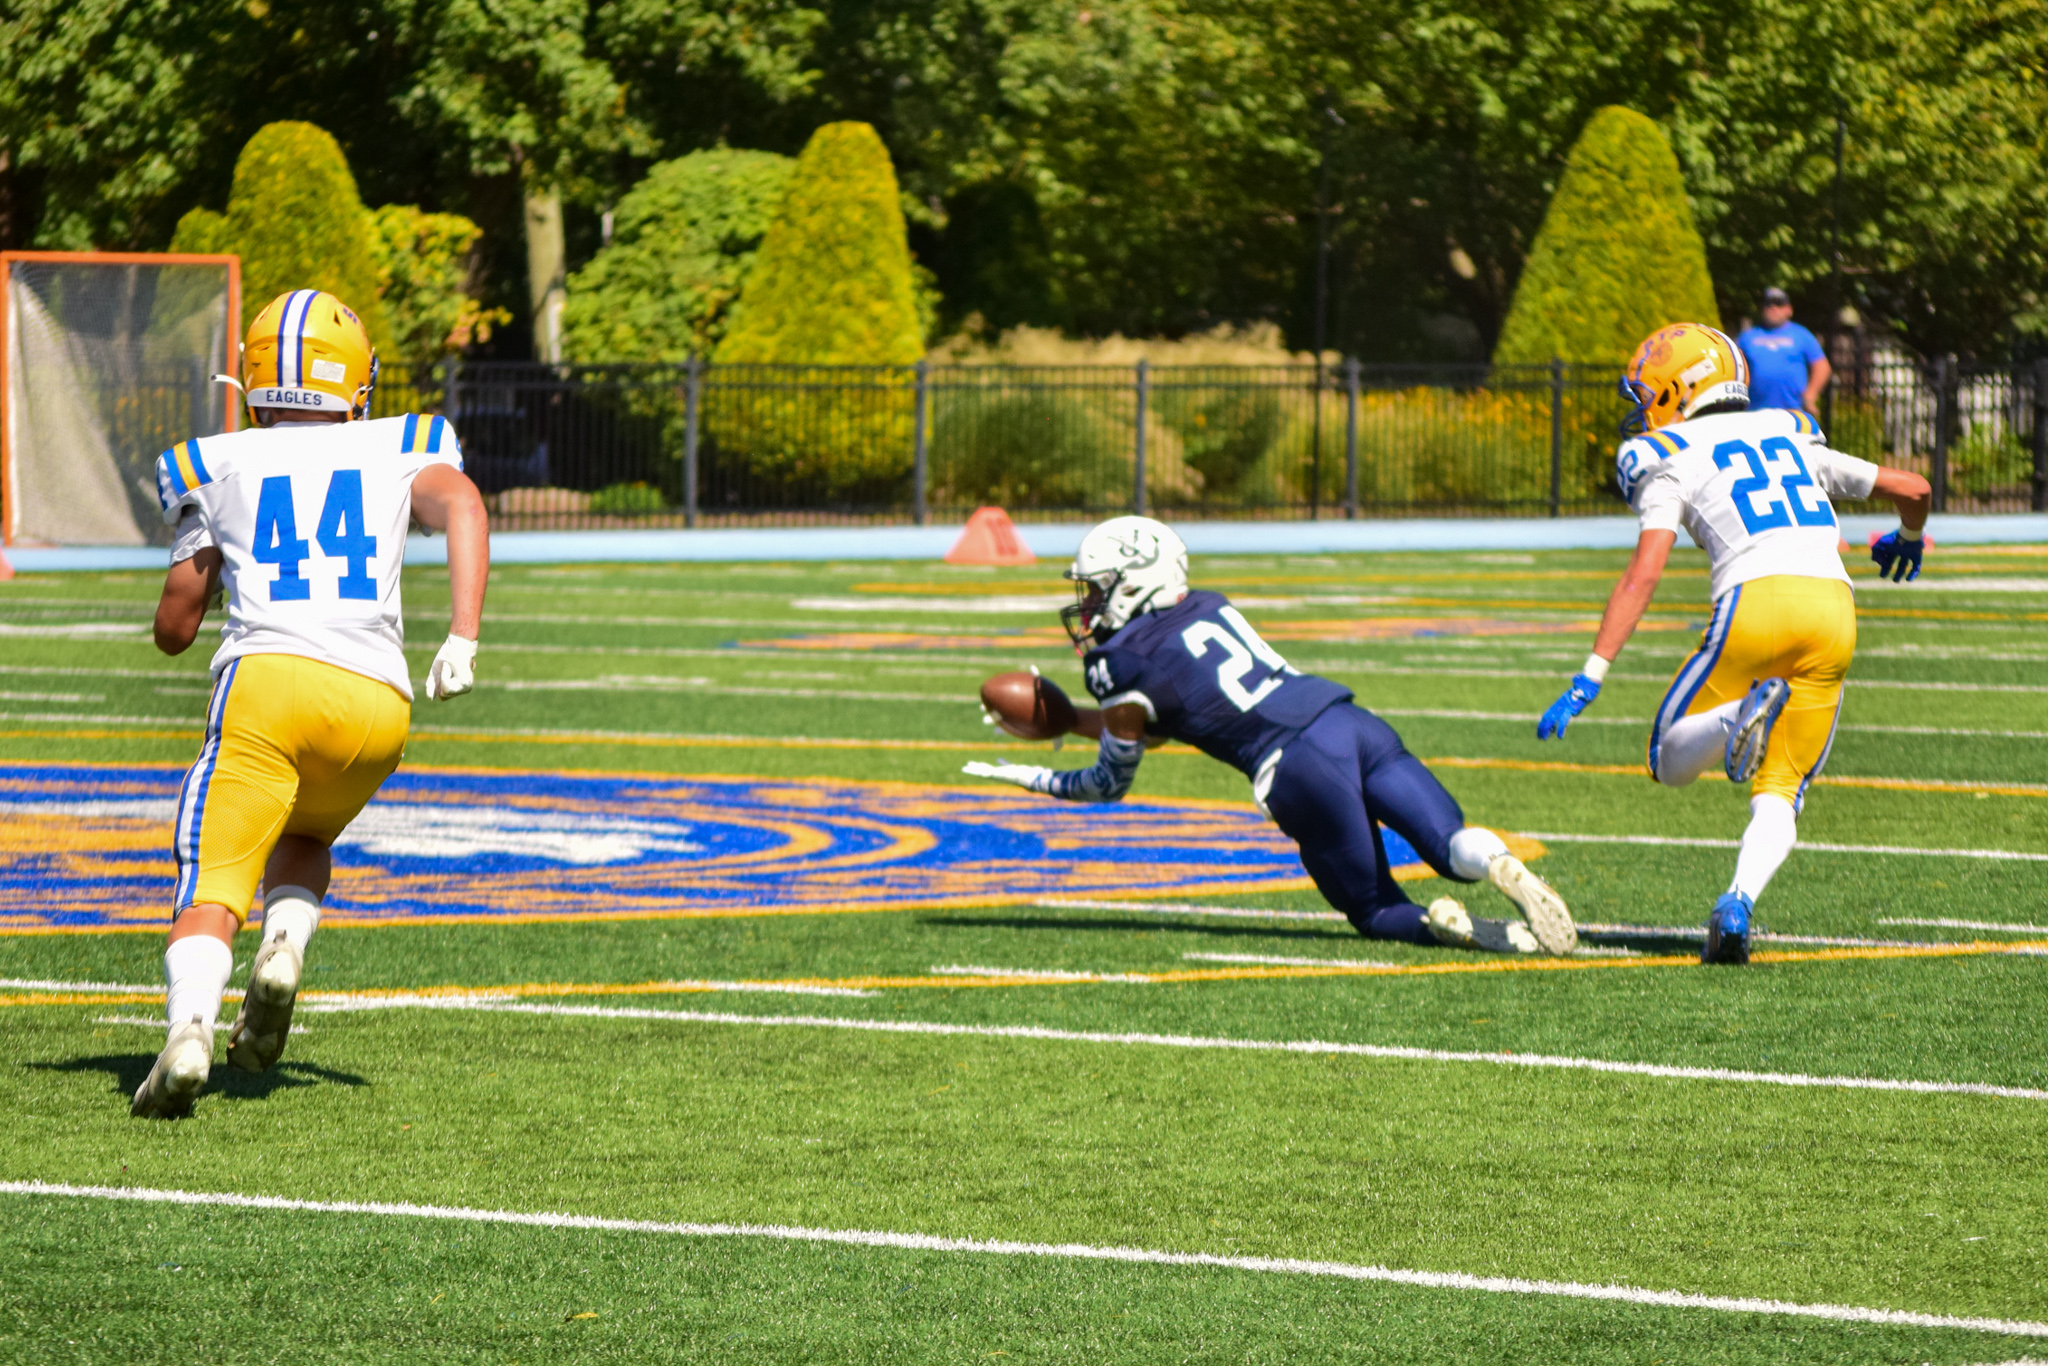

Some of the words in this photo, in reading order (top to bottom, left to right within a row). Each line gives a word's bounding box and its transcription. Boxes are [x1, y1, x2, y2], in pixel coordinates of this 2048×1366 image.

[266, 389, 323, 406] EAGLES
[252, 469, 378, 602] 44
[1712, 436, 1836, 536] 22
